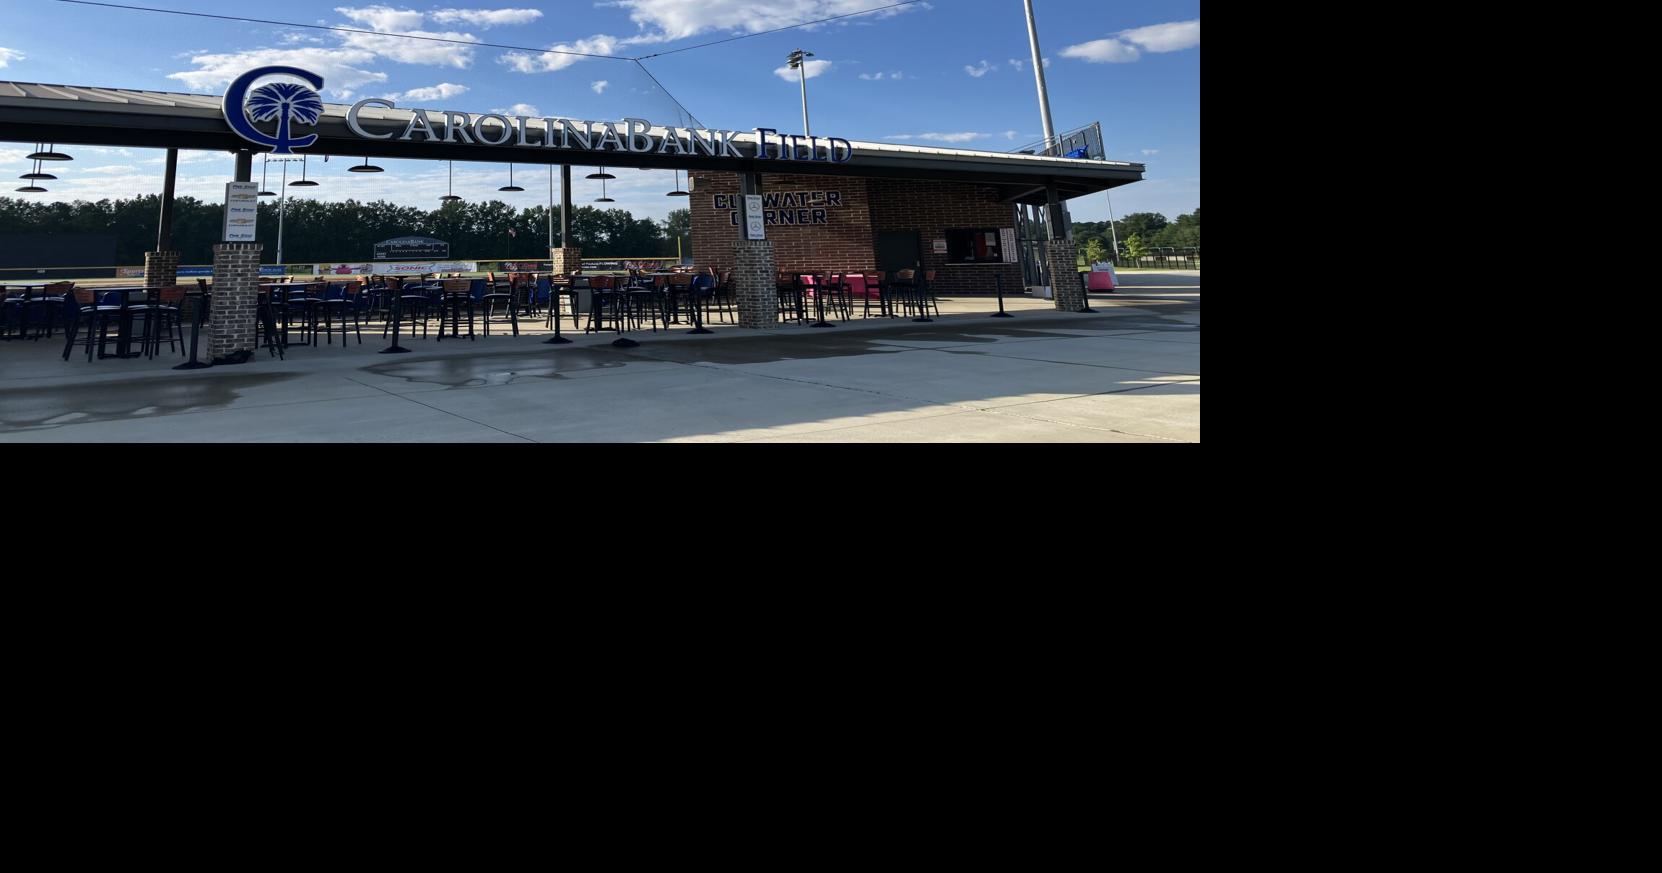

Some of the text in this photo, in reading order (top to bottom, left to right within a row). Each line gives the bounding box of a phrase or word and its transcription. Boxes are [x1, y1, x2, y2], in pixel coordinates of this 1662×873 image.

[753, 127, 853, 164] FIELD
[713, 191, 842, 209] CUWATER
[730, 208, 827, 226] CRNER
